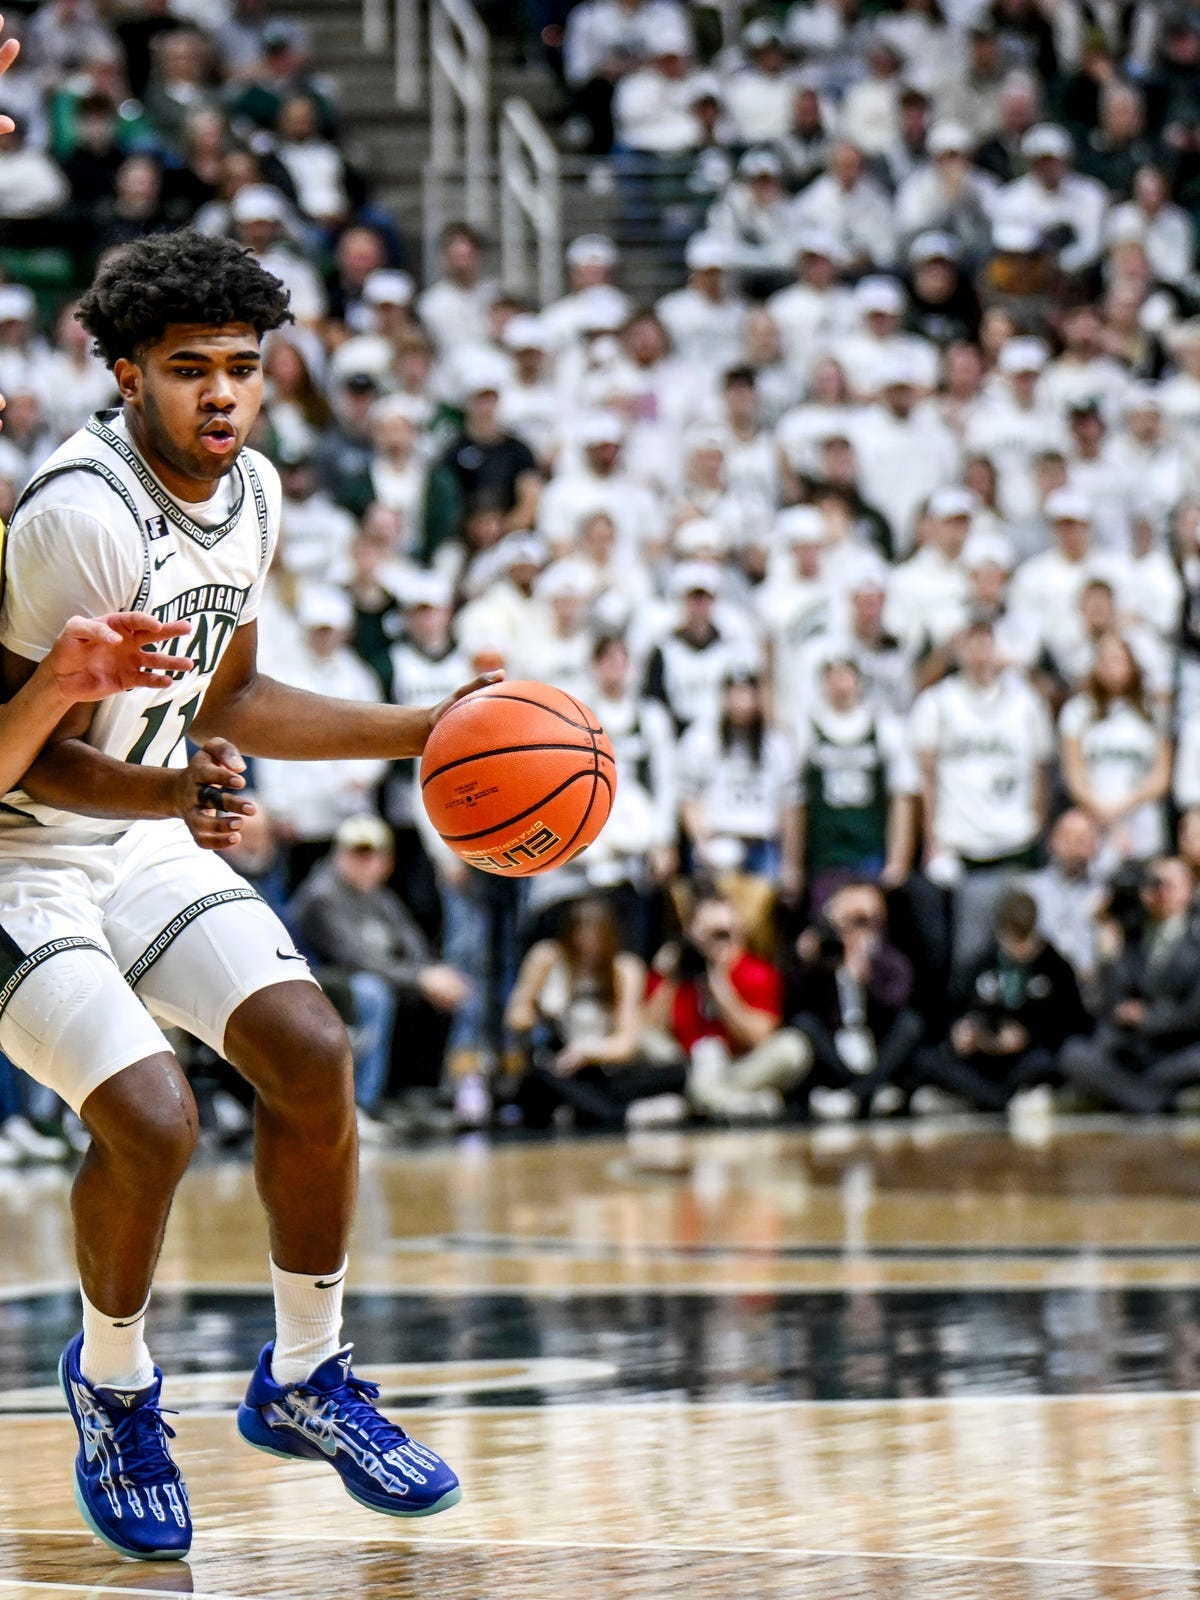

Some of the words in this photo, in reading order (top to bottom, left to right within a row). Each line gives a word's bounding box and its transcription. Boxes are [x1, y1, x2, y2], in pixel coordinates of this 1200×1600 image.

[166, 586, 242, 623] MICHIGAN
[125, 691, 201, 768] 11
[464, 825, 562, 871] ELITE
